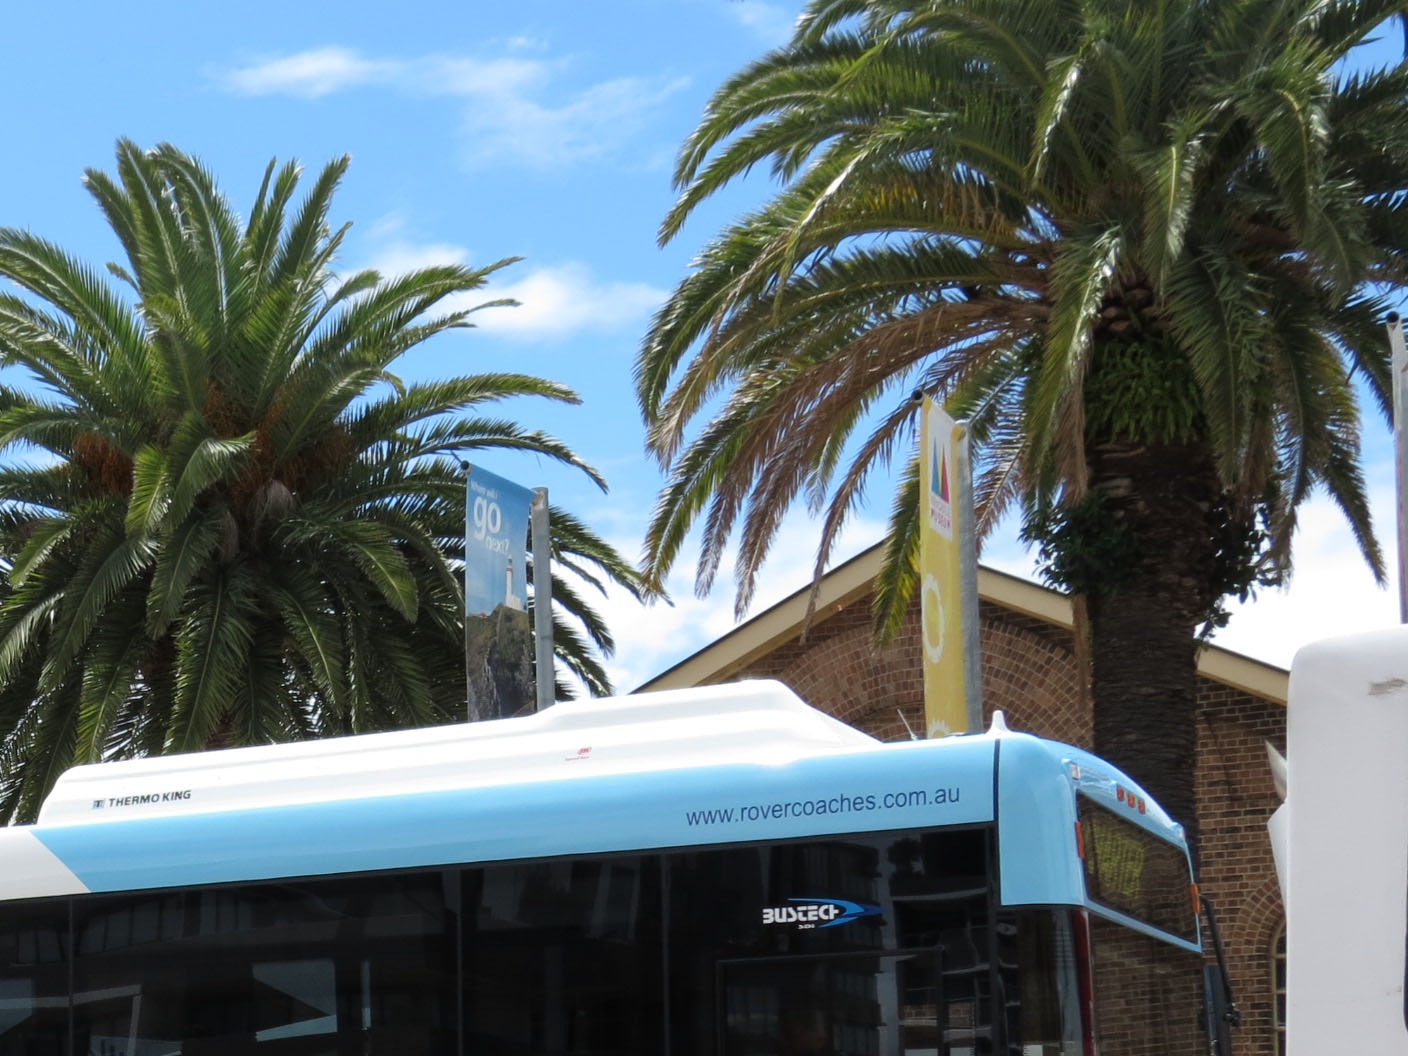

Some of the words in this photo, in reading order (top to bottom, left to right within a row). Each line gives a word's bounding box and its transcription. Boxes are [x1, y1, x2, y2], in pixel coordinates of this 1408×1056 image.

[473, 496, 502, 541] go
[108, 793, 161, 808] THERMO
[162, 789, 192, 803] KING
[686, 787, 961, 826] www.rovercoaches.com.au
[762, 904, 840, 925] BUSTECH
